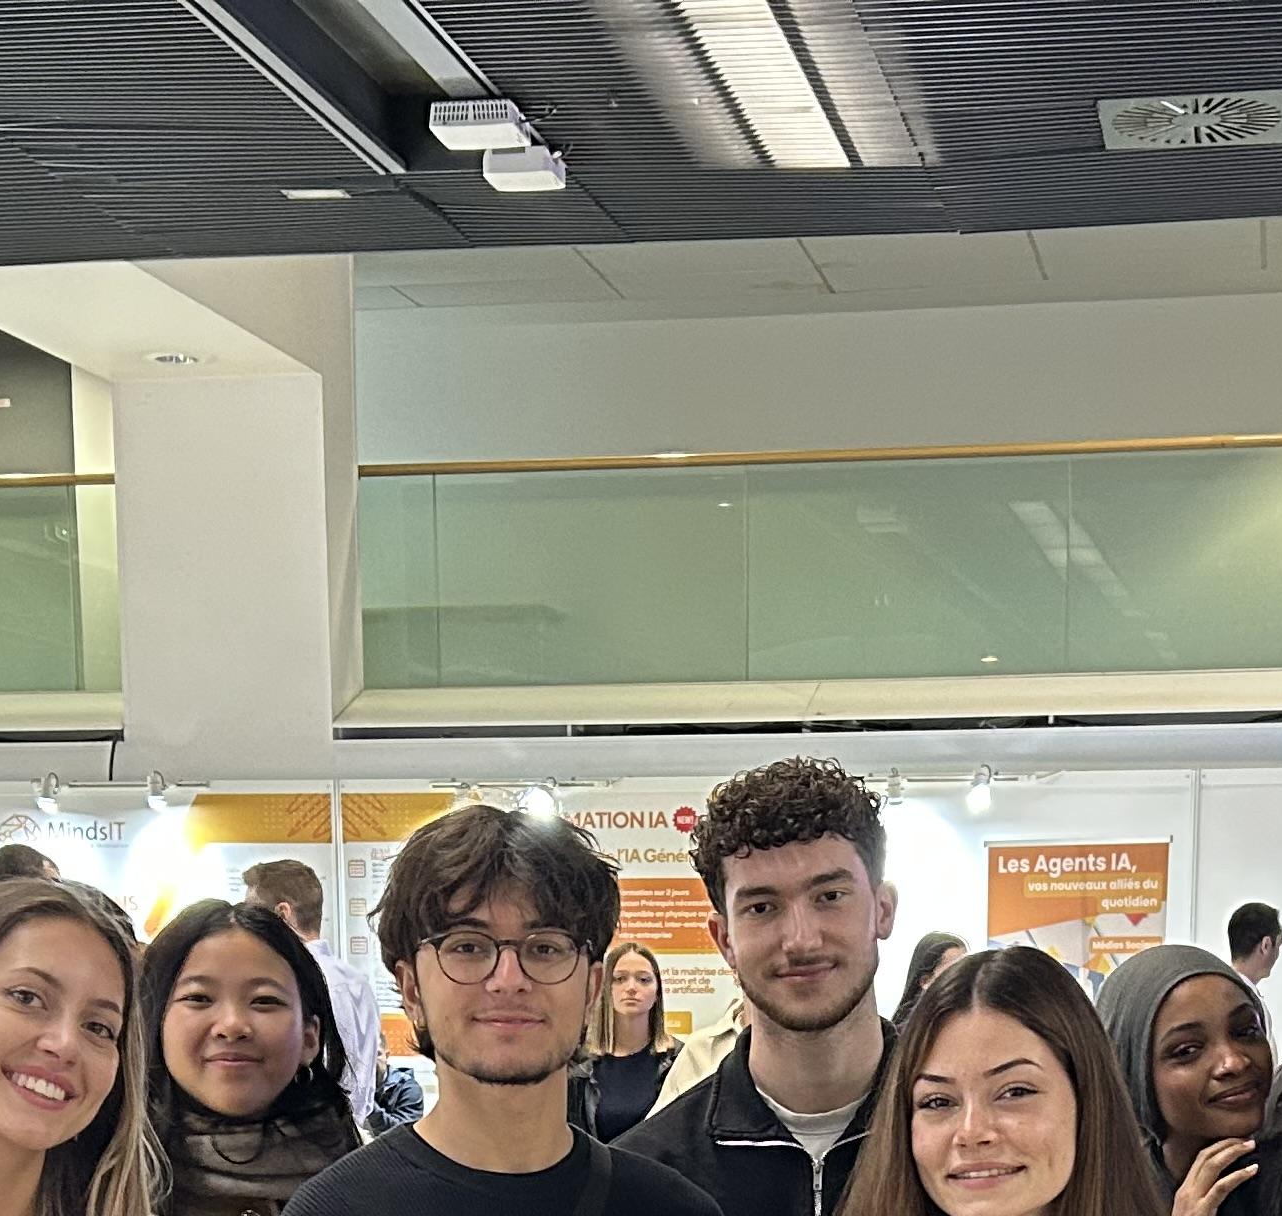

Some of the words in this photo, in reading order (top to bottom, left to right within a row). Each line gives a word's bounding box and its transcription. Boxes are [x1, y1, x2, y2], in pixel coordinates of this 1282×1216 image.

[649, 811, 668, 829] IA
[48, 820, 125, 841] MindsIT
[644, 848, 691, 863] Génér
[997, 855, 1030, 874] Les
[1033, 853, 1107, 878] Agents
[1110, 853, 1137, 873] IA,
[1028, 882, 1048, 892] vos
[1050, 881, 1108, 891] nouveaux
[1109, 879, 1141, 890] alliés
[1142, 879, 1159, 889] du
[1101, 897, 1158, 911] quotidien
